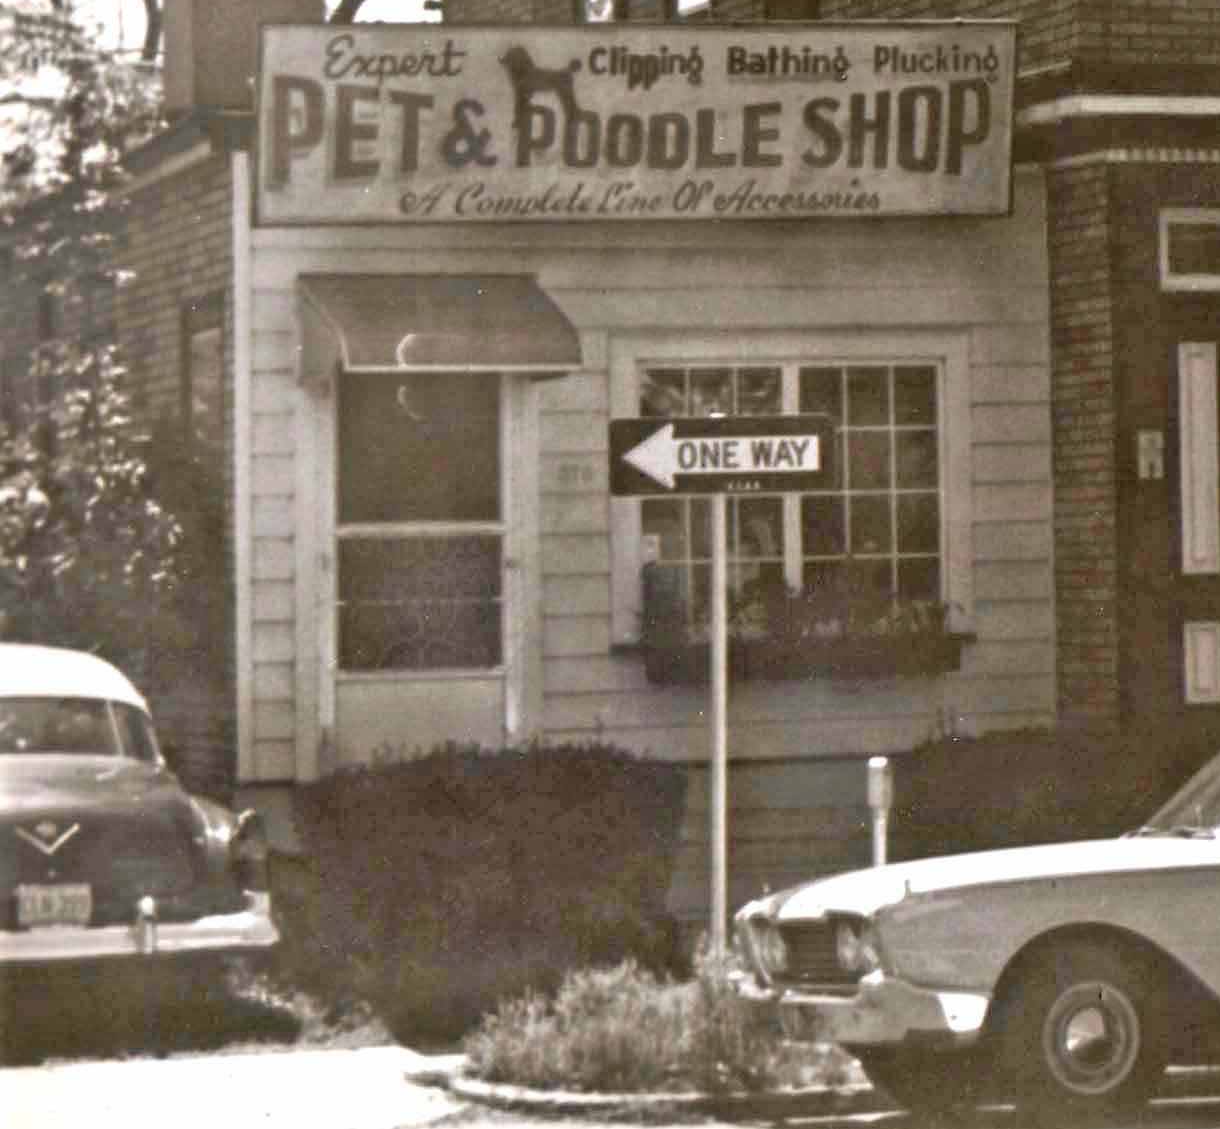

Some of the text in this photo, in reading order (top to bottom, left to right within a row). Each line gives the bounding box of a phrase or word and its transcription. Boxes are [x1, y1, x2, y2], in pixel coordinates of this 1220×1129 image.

[322, 33, 999, 91] Expert Clipping Bathing Plucking
[267, 74, 992, 189] PET & POODLE SHOP
[401, 182, 449, 216] A
[455, 182, 592, 215] Complete
[597, 180, 663, 214] Line
[713, 178, 882, 213] Accessories
[676, 438, 810, 470] ONE WAY
